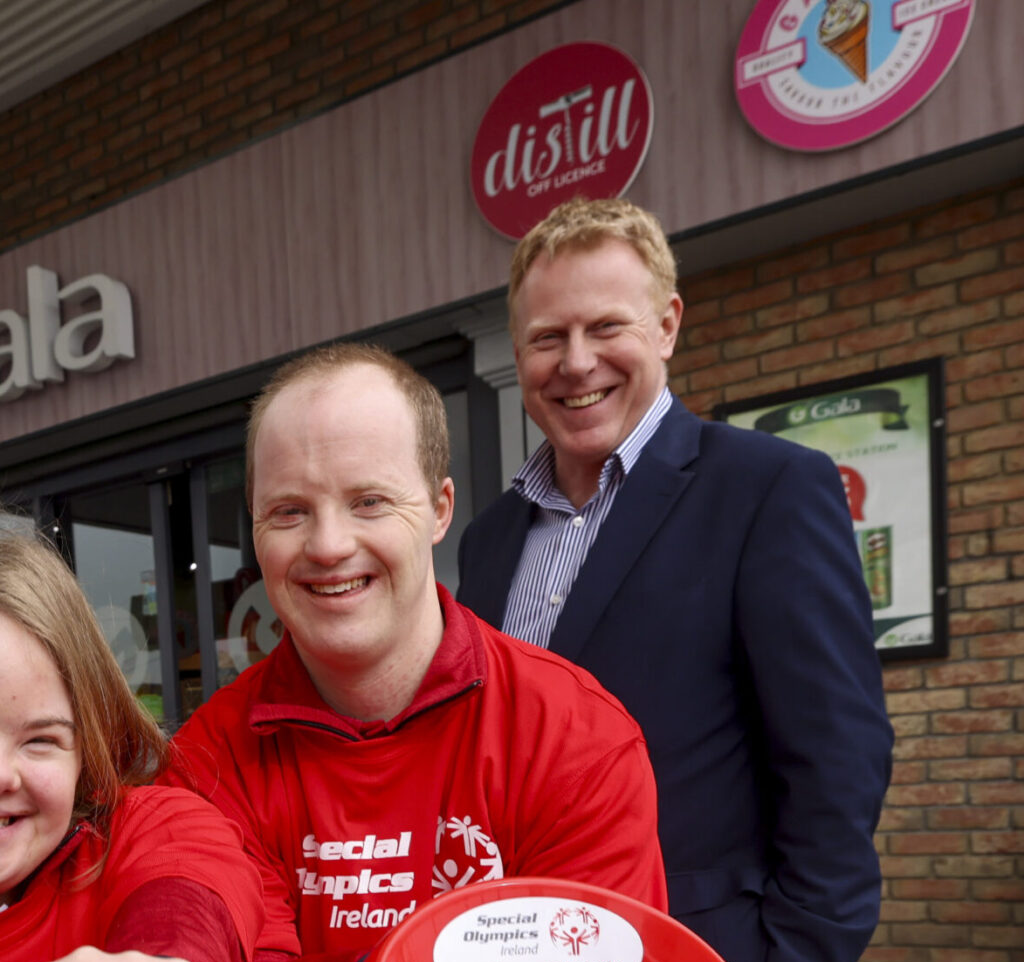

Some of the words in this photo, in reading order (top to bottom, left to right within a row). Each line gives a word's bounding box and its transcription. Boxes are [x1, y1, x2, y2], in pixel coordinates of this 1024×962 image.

[527, 179, 552, 198] OFF
[553, 160, 607, 188] LICENCE
[810, 396, 861, 420] Gala
[302, 831, 412, 861] Secial
[476, 912, 538, 928] Special
[463, 929, 539, 945] Olympics
[500, 944, 539, 956] Ireland
